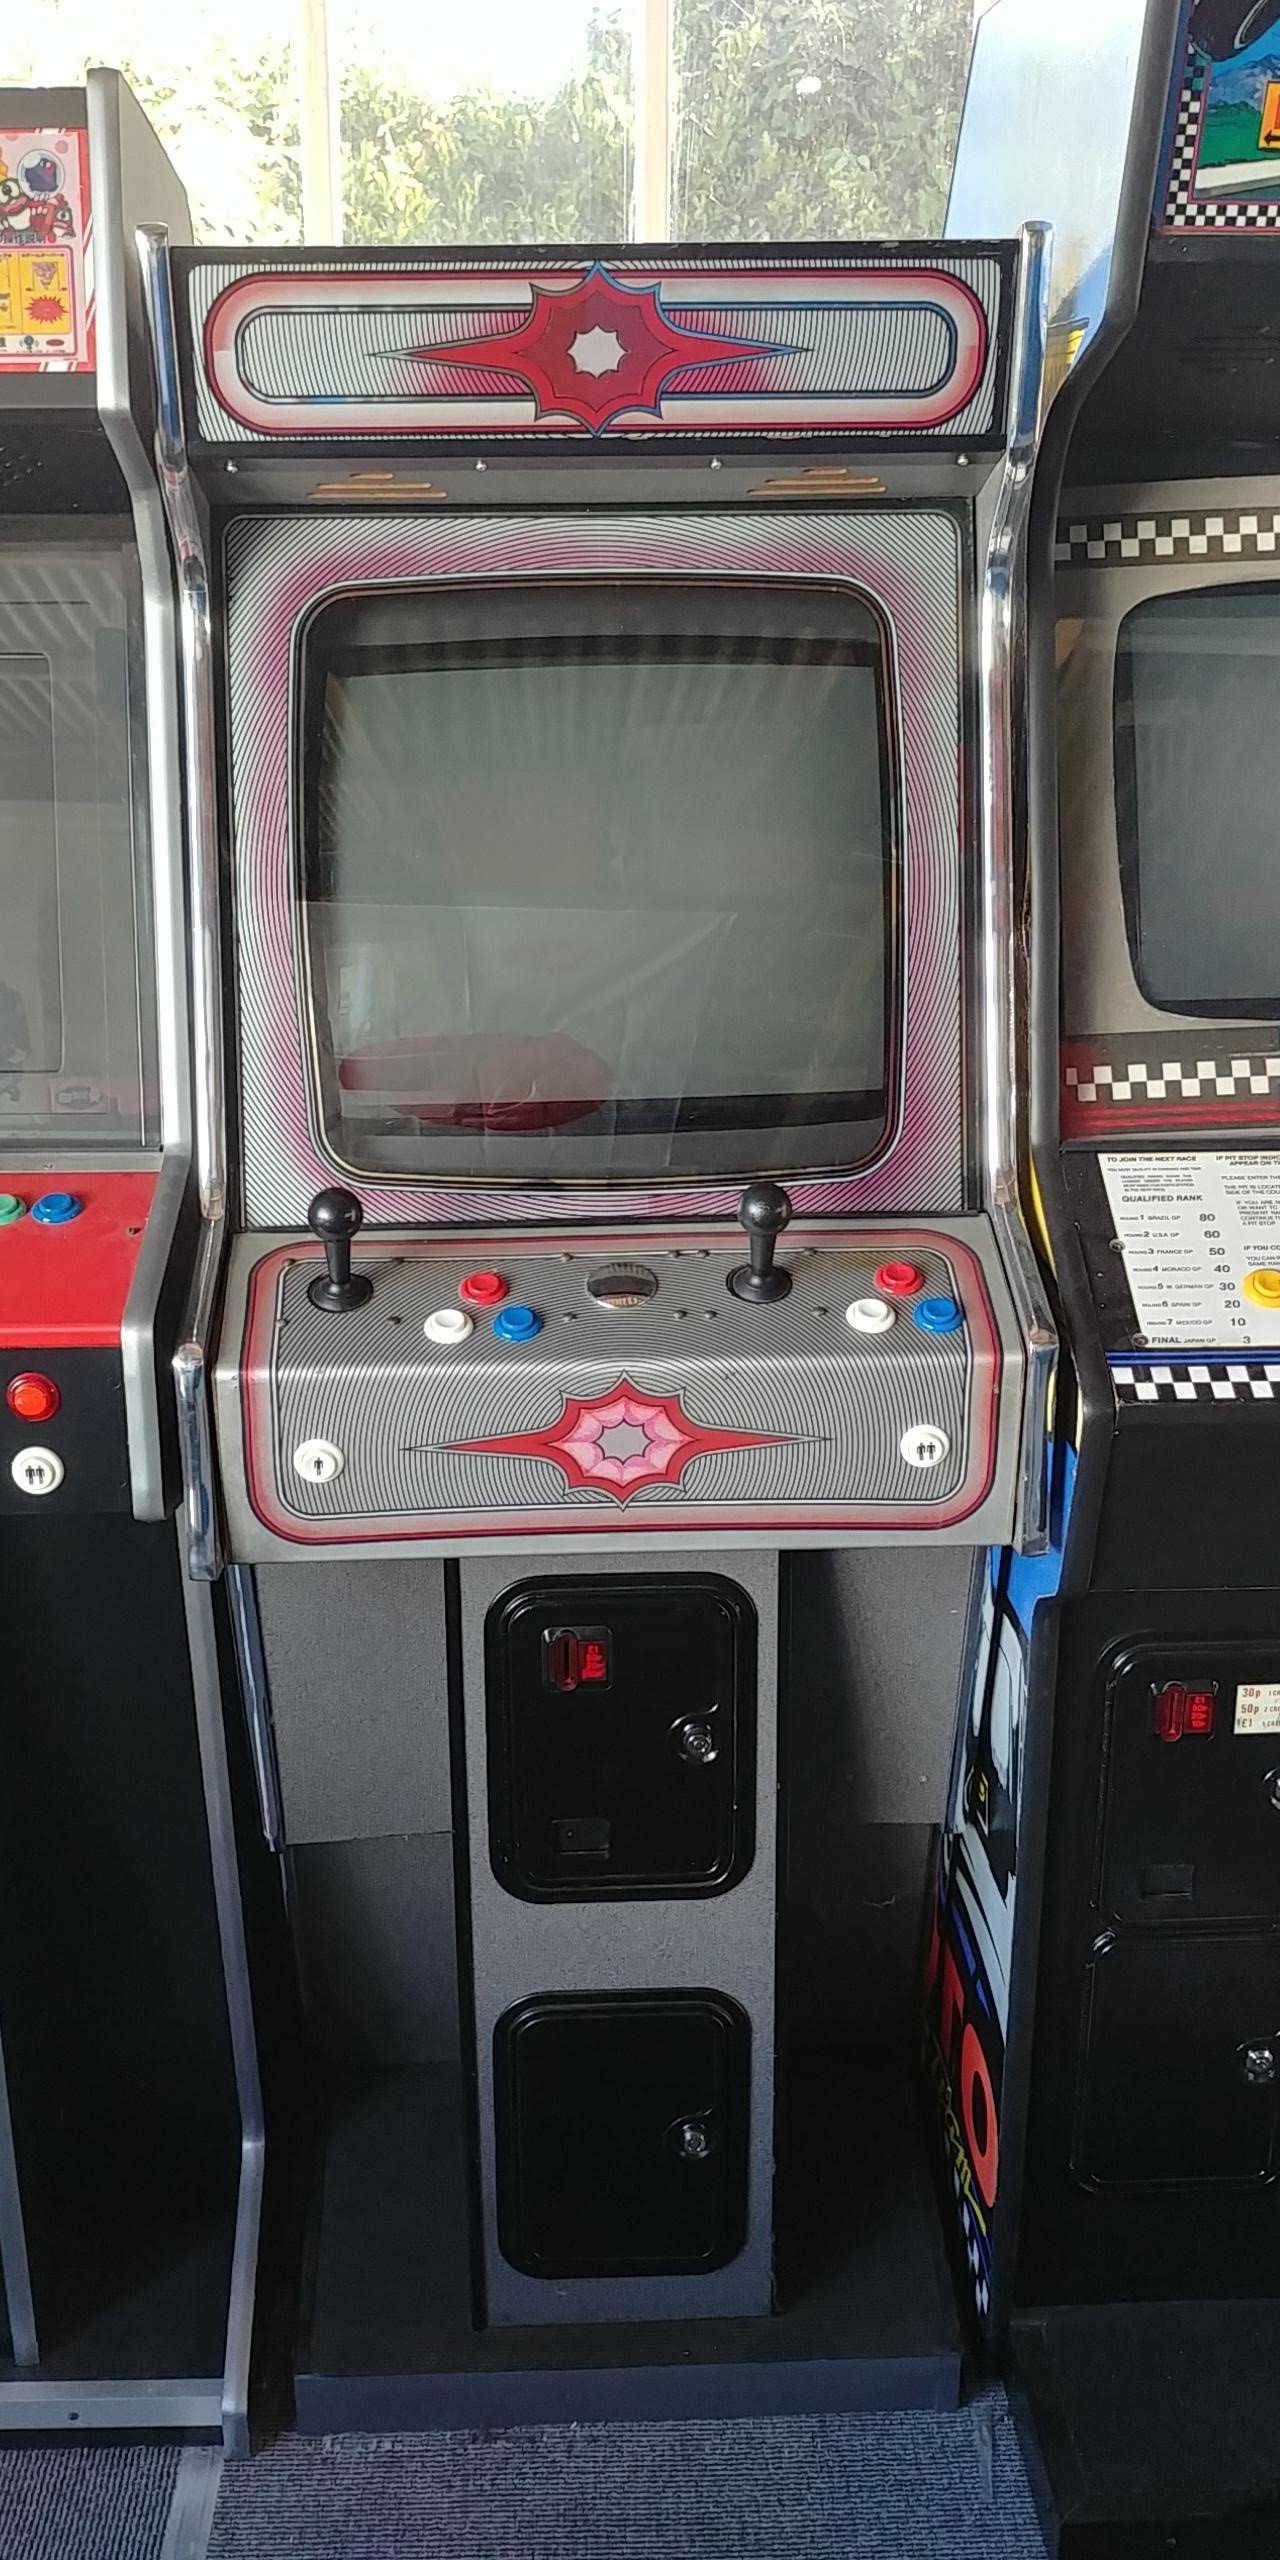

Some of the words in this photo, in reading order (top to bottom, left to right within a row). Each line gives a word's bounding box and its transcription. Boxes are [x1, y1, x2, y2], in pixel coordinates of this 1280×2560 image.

[1204, 1230, 1220, 1238] 60
[1219, 1282, 1235, 1290] 30
[1224, 1300, 1240, 1308] 20
[1231, 1318, 1246, 1326] 10
[1243, 1336, 1251, 1344] 3
[1242, 1688, 1261, 1698] 30p
[1241, 1704, 1259, 1714] 50p
